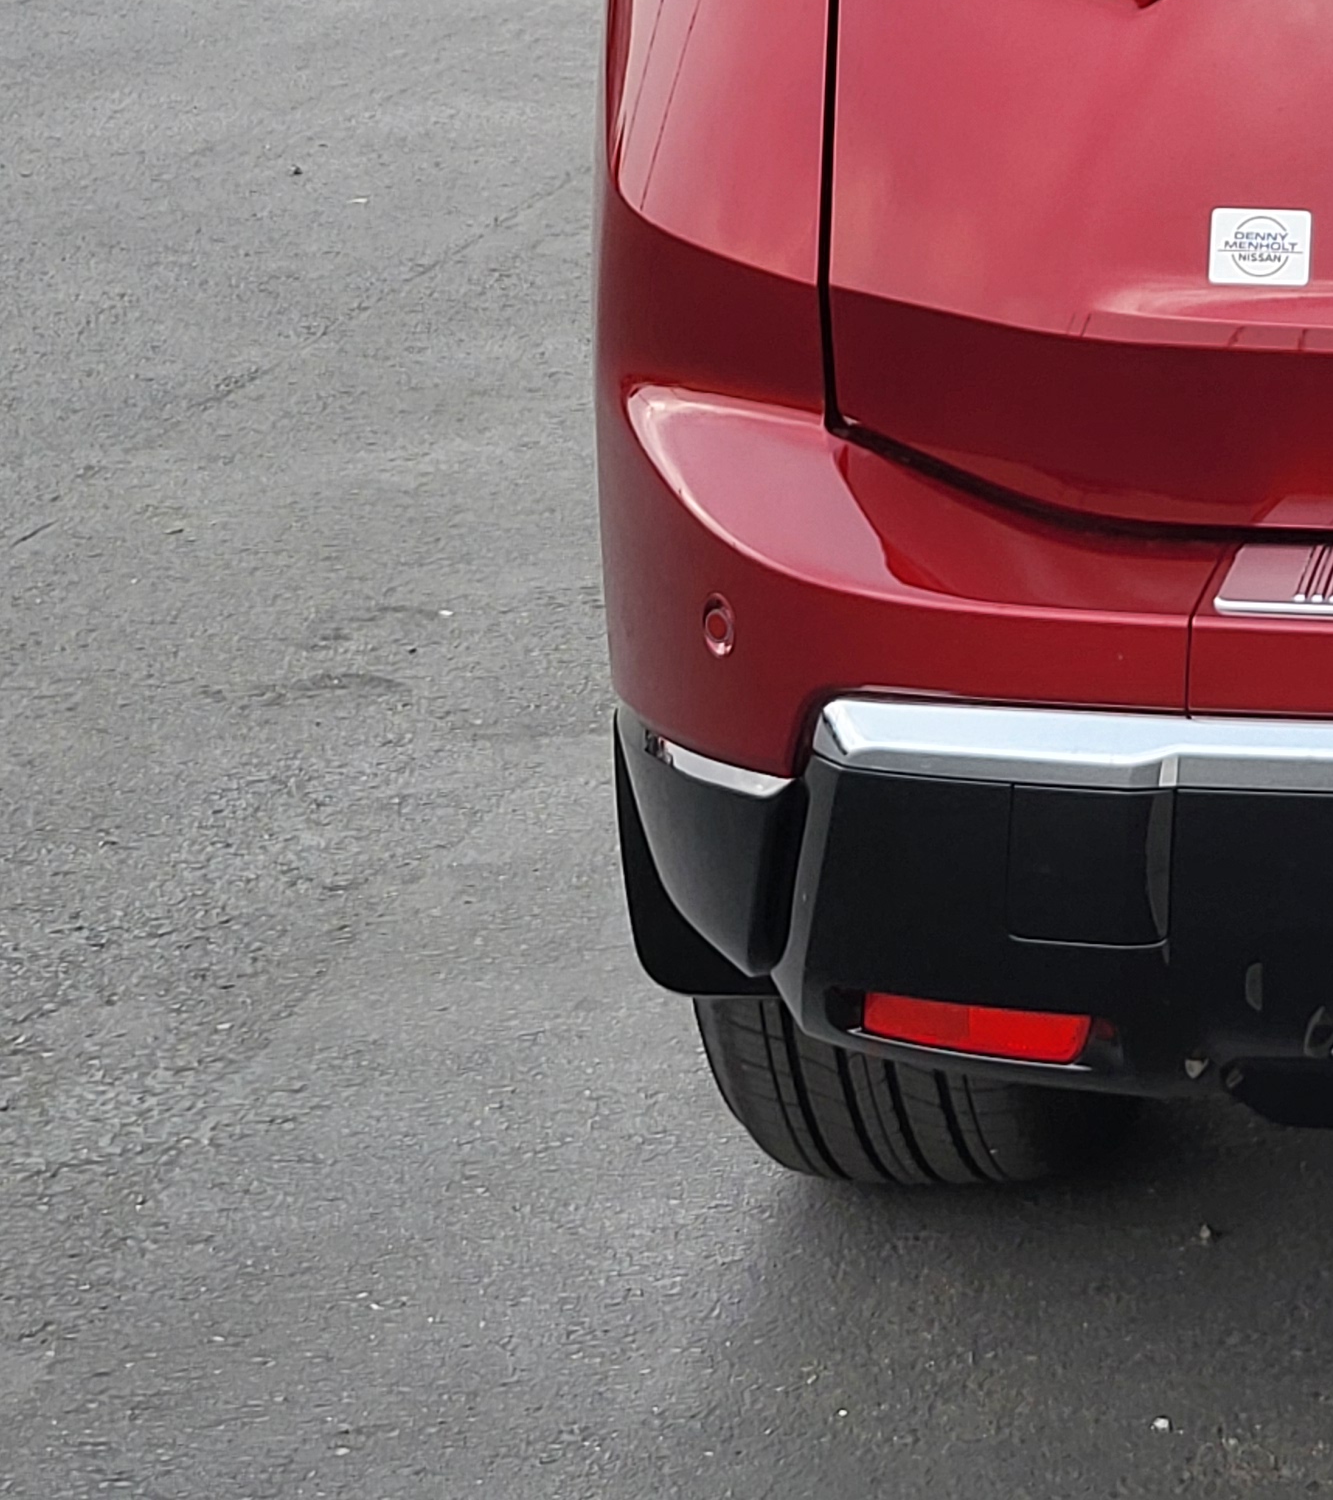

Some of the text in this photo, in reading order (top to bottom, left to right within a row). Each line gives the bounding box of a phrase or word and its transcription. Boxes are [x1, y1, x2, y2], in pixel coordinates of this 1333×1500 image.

[1233, 231, 1289, 242] DENNY
[1223, 240, 1299, 252] MENHOLT
[1238, 252, 1282, 263] NISSAN
